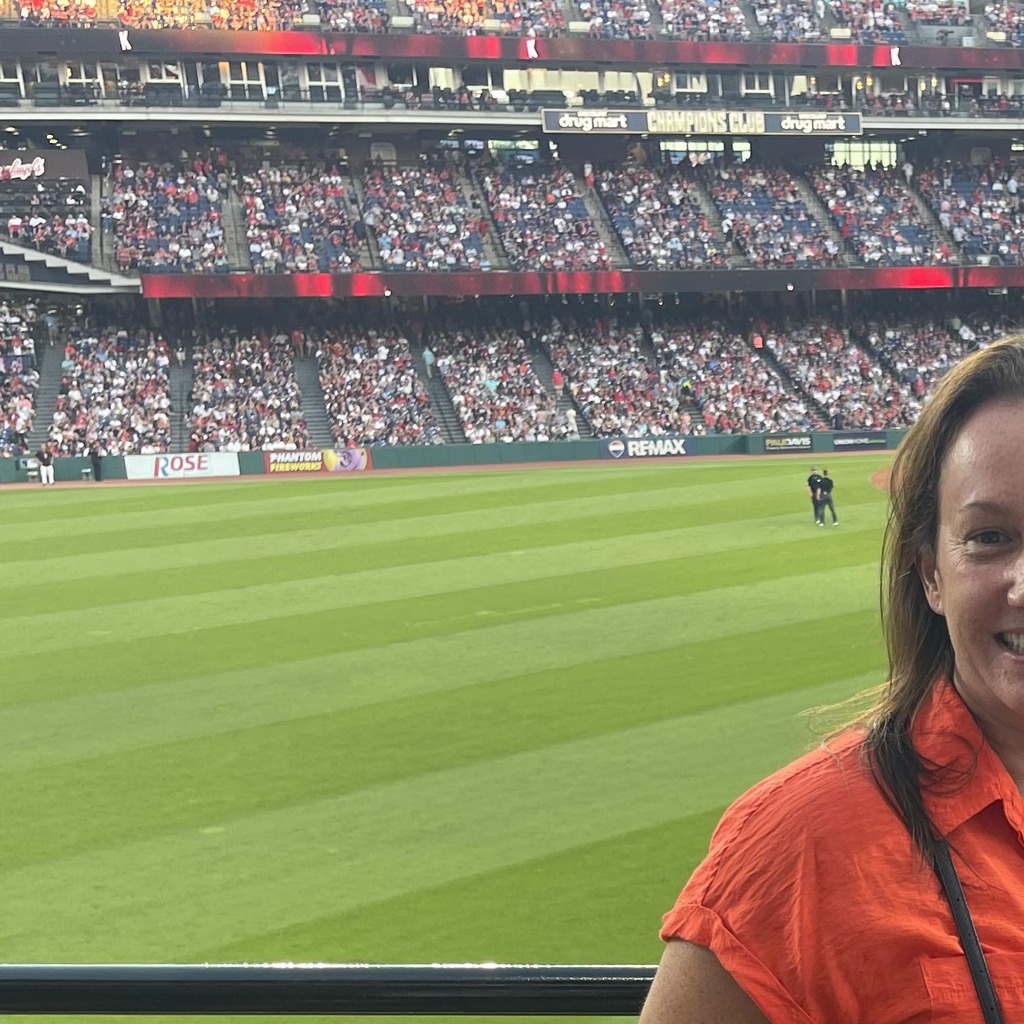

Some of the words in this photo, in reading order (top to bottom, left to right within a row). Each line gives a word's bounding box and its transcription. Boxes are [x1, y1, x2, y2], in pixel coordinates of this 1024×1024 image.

[118, 30, 132, 51] K
[526, 39, 539, 59] K
[559, 114, 593, 132] drug
[593, 115, 628, 128] mart
[647, 111, 727, 133] CHAMPIONS
[729, 111, 765, 133] CLUB
[780, 116, 813, 133] drug
[813, 117, 846, 130] mart
[153, 456, 209, 477] ROSE
[269, 451, 322, 463] PHANTOM
[269, 461, 323, 473] FIREWORKS
